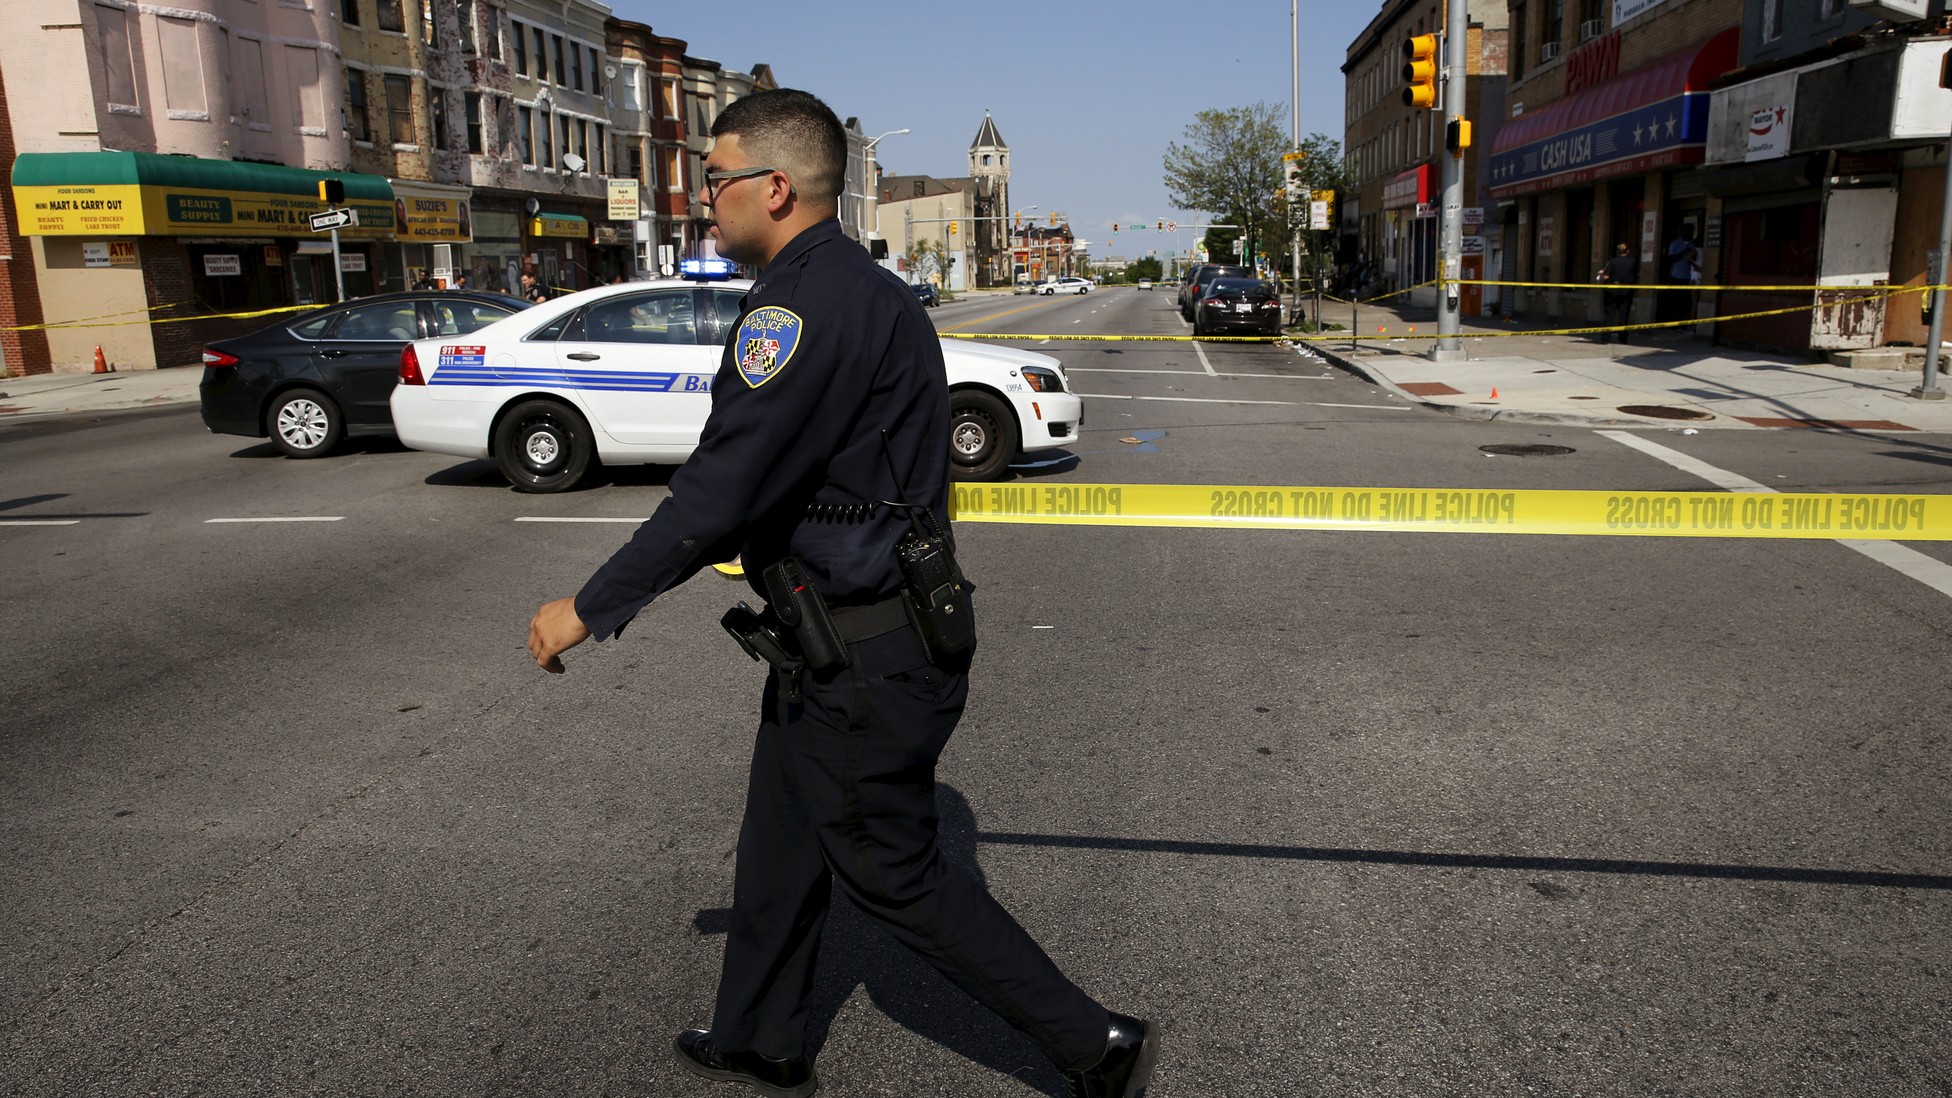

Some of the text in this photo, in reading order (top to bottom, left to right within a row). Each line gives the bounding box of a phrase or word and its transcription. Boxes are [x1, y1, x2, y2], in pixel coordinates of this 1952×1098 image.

[1564, 29, 1621, 97] PAWN
[1753, 114, 1773, 124] MAYOR
[1541, 132, 1591, 171] CASH USA
[50, 200, 70, 210] MART
[73, 200, 79, 209] &
[81, 200, 104, 210] CARRY
[107, 200, 122, 210] OUT
[180, 199, 220, 209] BEAUTY
[270, 199, 288, 208] FOUR
[415, 200, 447, 211] SUZIE'S
[181, 211, 220, 220] SUPPLY
[237, 210, 255, 221] MINI
[257, 209, 285, 223] MART
[288, 210, 295, 224] &
[110, 242, 135, 257] ATM
[745, 310, 796, 328] BALTIMORE
[751, 320, 784, 332] POLICE
[441, 346, 456, 355] 911
[440, 356, 454, 365] 311
